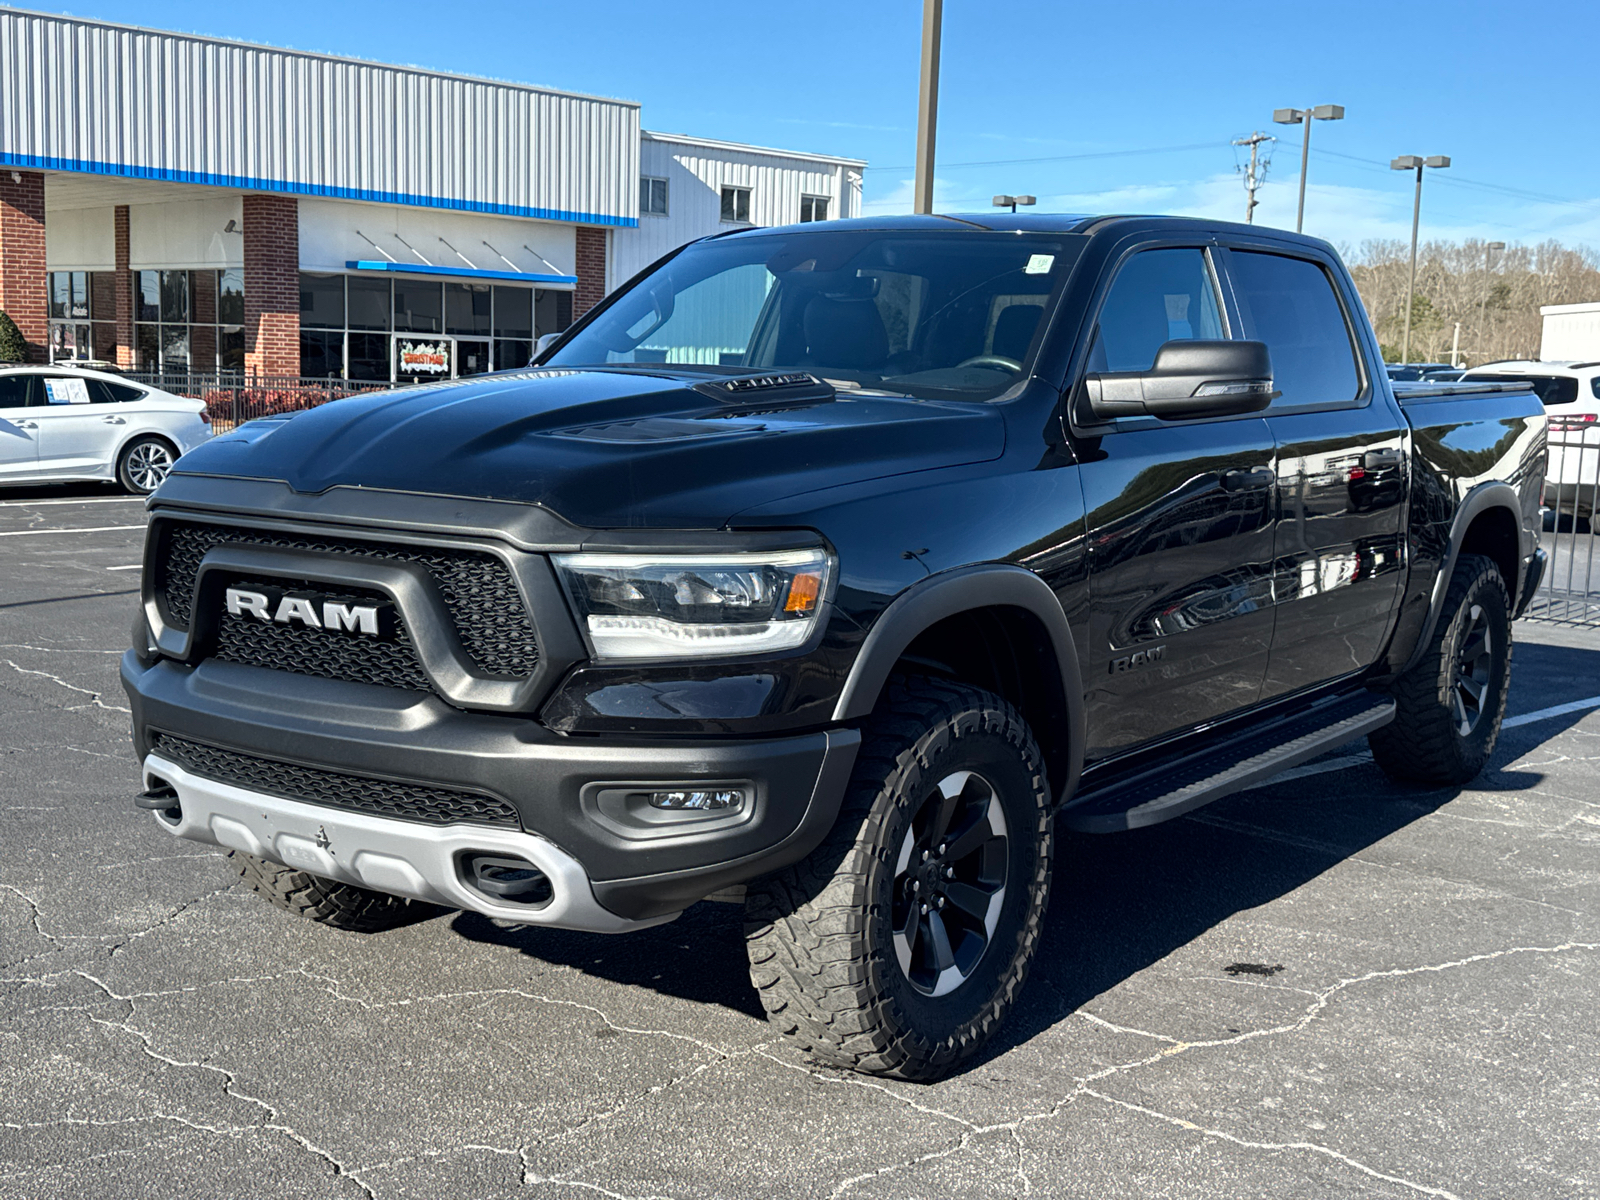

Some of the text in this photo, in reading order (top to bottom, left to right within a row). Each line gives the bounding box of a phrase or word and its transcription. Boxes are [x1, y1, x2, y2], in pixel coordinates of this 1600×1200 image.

[404, 352, 444, 366] CHRISTMAS
[226, 588, 379, 635] RAM
[1108, 645, 1167, 675] RAM
[1017, 820, 1034, 921] TOYO
